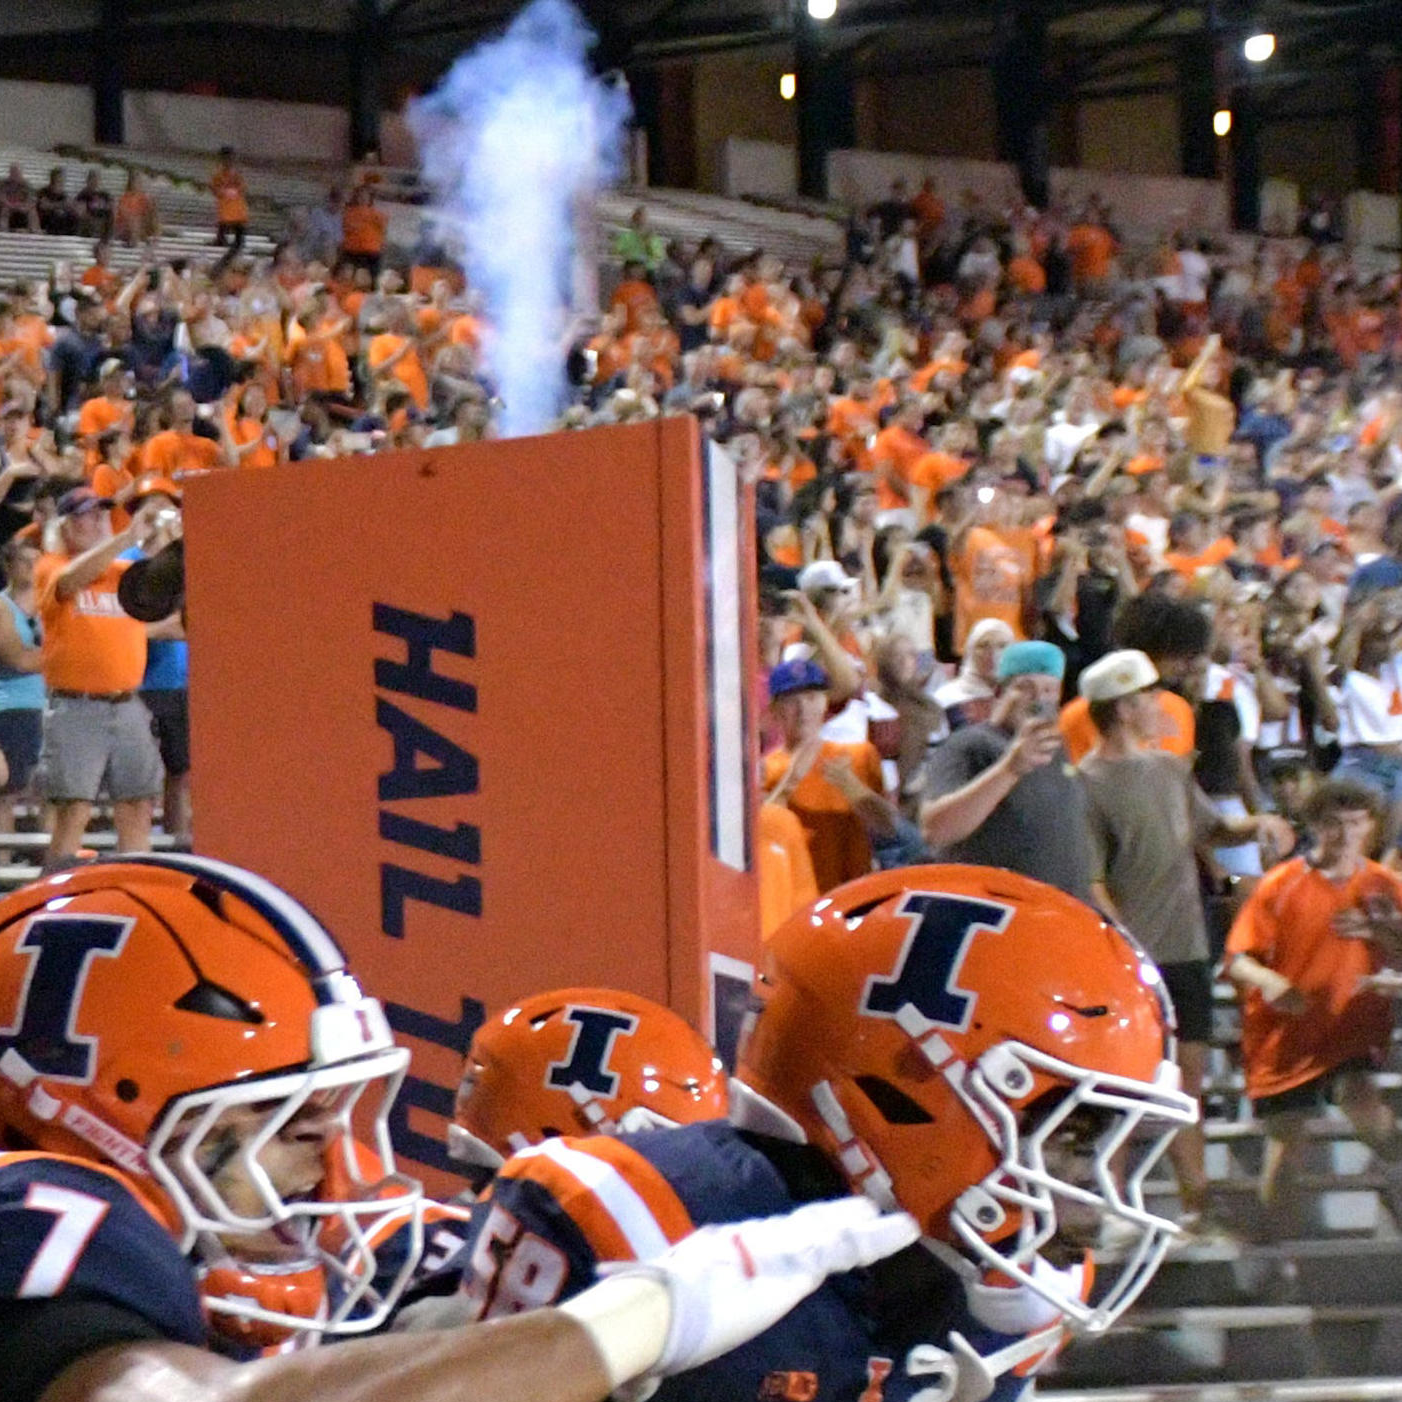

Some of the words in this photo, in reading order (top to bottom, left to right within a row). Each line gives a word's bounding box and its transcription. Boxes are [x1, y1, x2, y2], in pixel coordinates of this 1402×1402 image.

[372, 601, 483, 939] HAIL
[860, 890, 1016, 1032] I
[545, 1004, 639, 1100] I
[23, 1181, 111, 1300] 7
